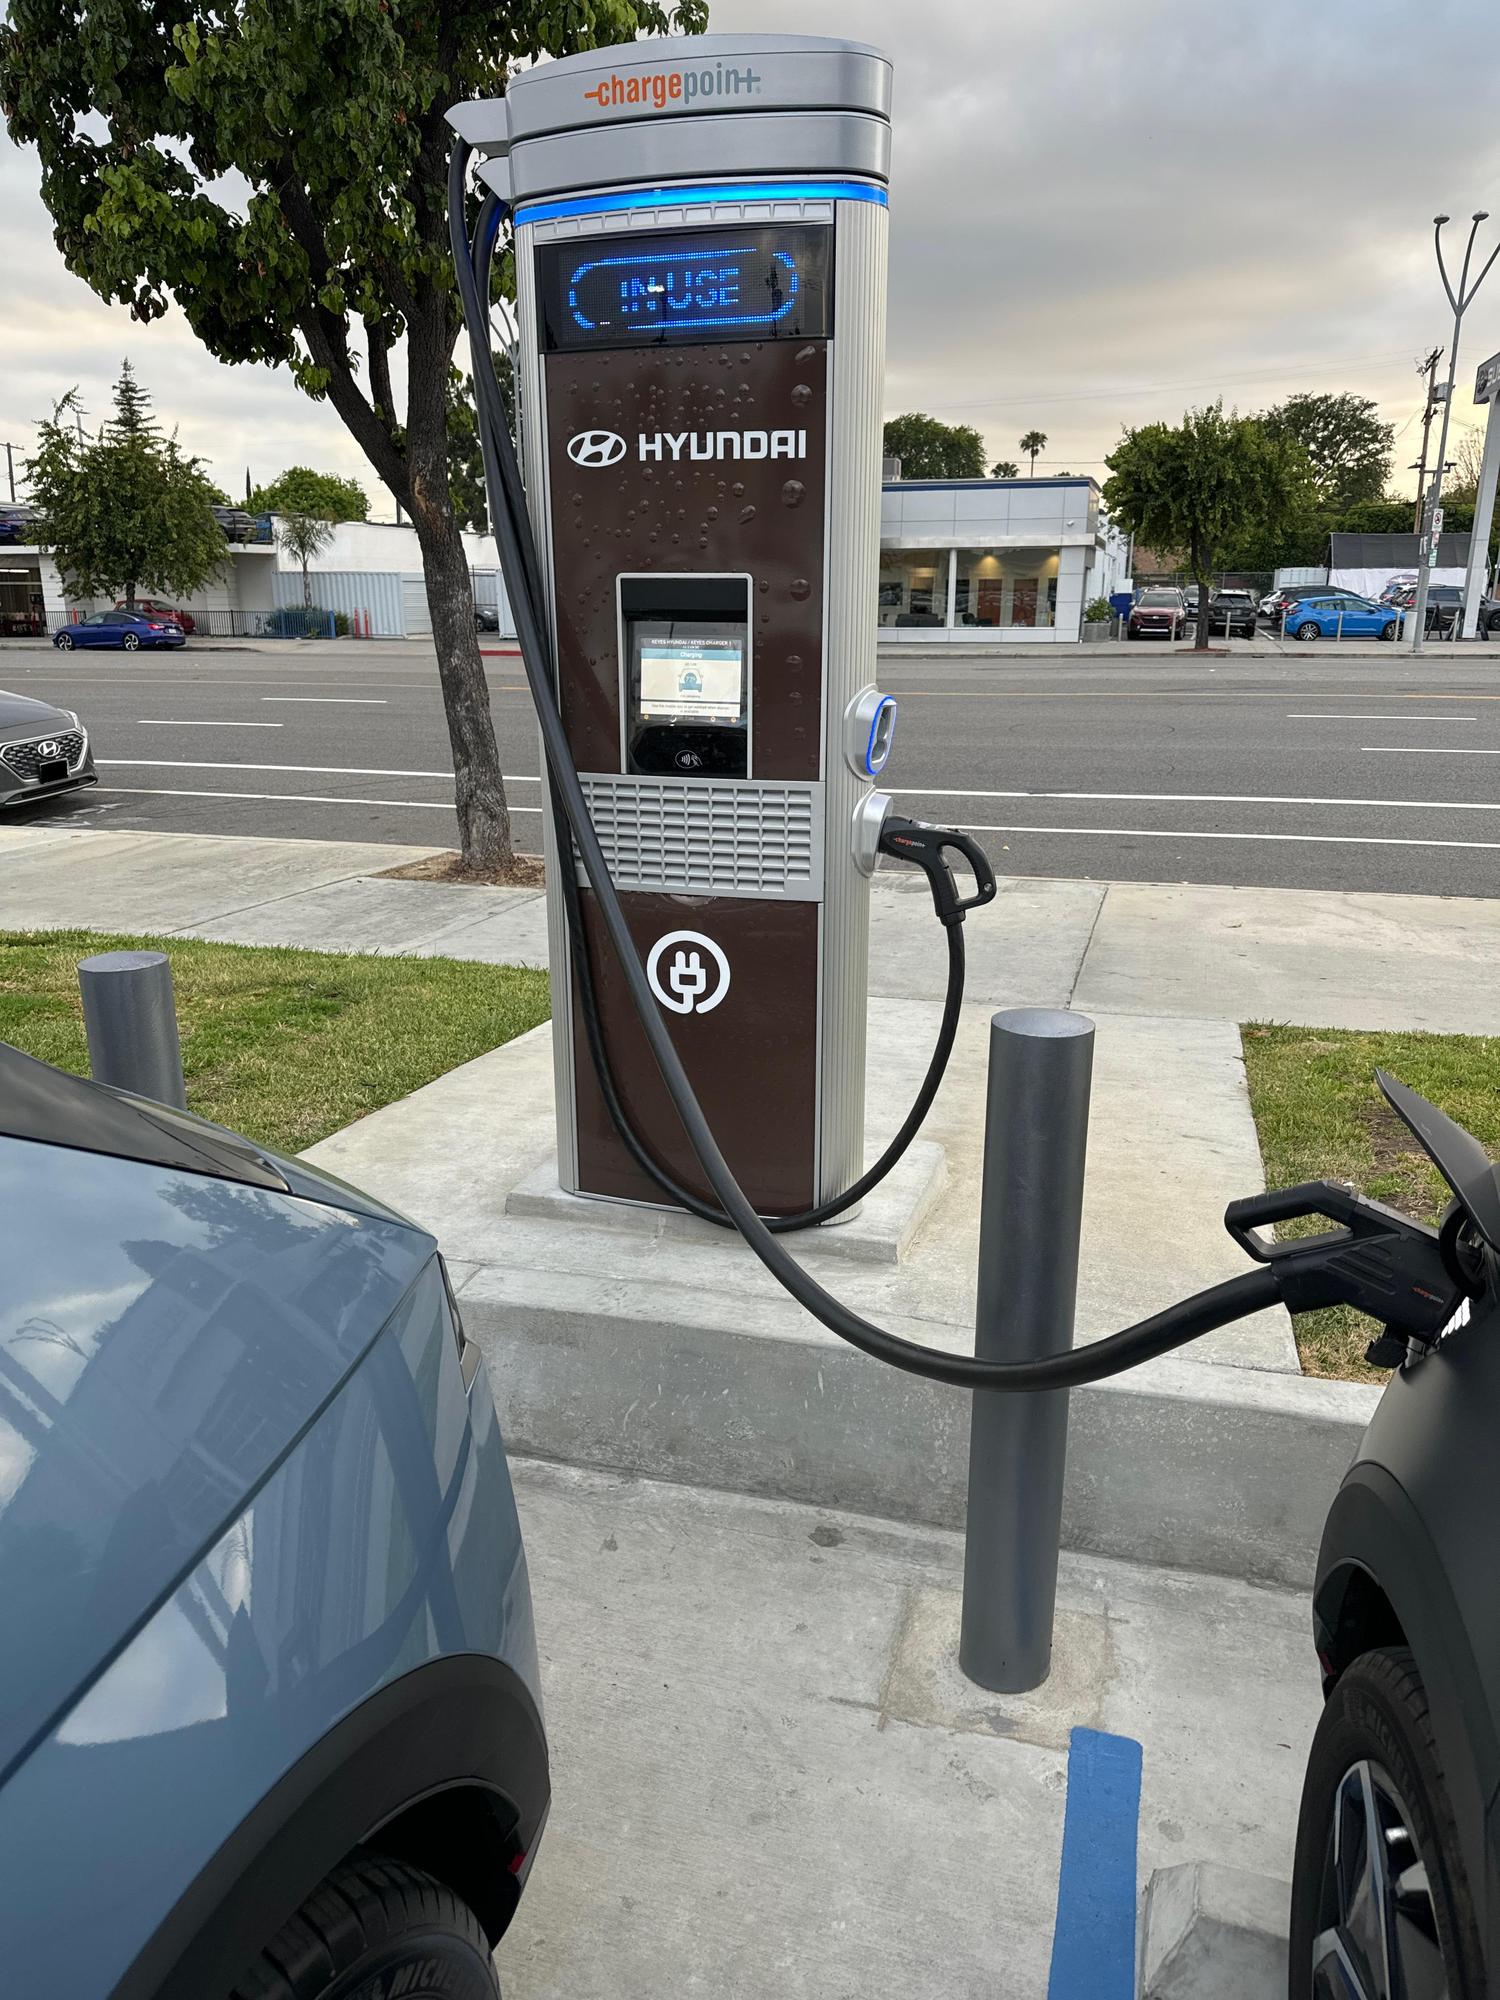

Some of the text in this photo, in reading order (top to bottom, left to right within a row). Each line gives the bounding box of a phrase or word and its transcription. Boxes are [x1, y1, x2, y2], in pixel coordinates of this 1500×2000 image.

[620, 267, 740, 312] IN USE
[638, 429, 808, 461] HYUNDAI
